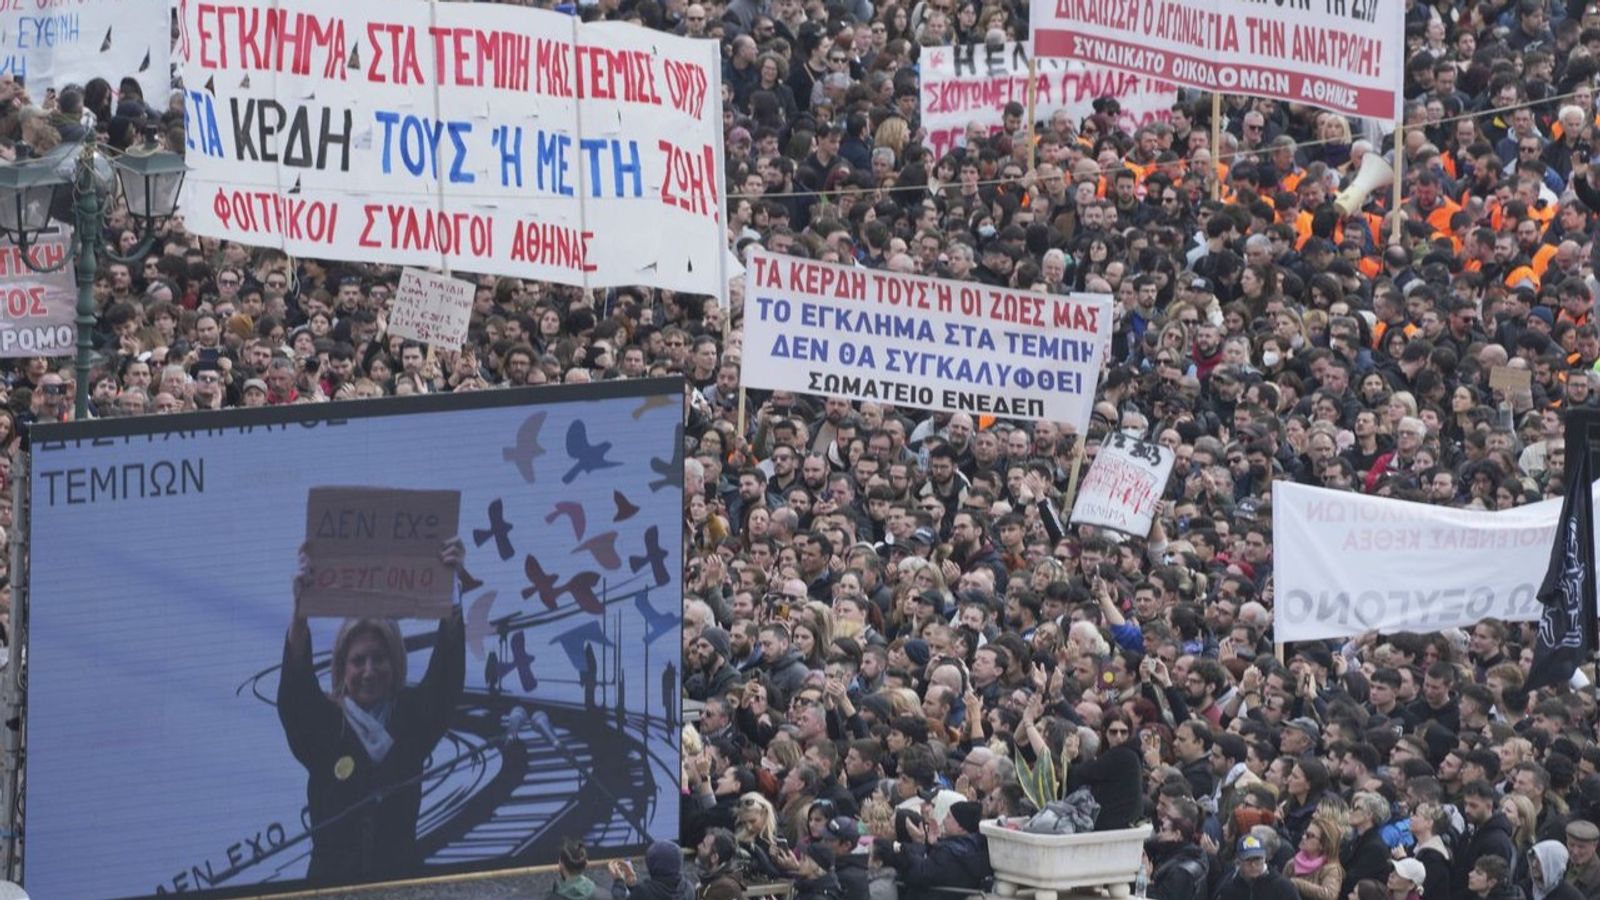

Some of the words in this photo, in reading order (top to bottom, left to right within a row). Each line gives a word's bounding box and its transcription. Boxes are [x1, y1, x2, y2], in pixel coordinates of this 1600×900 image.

[198, 4, 346, 80] ΕΓΚΛΗΜΑ
[367, 22, 424, 85] ΣΤΑ
[429, 27, 530, 92] ΤΕΜΠΗ
[536, 38, 573, 97] ΜΑΣ
[575, 45, 662, 105] ΓΕΜΙΣΕ
[1156, 2, 1204, 48] ΑΓΩΝΑΣ
[1208, 13, 1240, 53] ΓΙΑ
[1246, 17, 1286, 60] ΤΗΝ
[1061, 70, 1141, 106] ΠΑΙΔΙΑ
[1073, 36, 1165, 74] ΣΥΝΔΙΚΑΤΟ
[1172, 57, 1290, 94] ΟΙΚΟΔΟΜΩΝ
[1301, 77, 1358, 110] ΑΘΗΝΑΣ
[230, 97, 352, 171] ΚΕΡΔΗ
[375, 111, 475, 183] ΤΟΥΣ
[537, 131, 574, 196] ΜΕ
[580, 140, 643, 197] ΤΗ
[358, 205, 493, 258] ΣΥΛΛΟΓΟΙ
[510, 220, 598, 271] ΑΘΗΝΑΣ
[753, 257, 783, 290] ΤΑ
[790, 264, 867, 301] ΚΕΡΔΗ
[873, 276, 930, 310] ΤΟΥΣ
[960, 291, 982, 318] ΟΙ
[989, 292, 1046, 328] ΖΩΕΣ
[1053, 302, 1100, 334] ΜΑΣ
[757, 297, 791, 324] ΤΟ
[800, 304, 935, 344] ΕΓΚΛΗΜΑ
[944, 322, 996, 352] ΣΤΑ
[1004, 332, 1095, 364] ΤΕΜΠΗ
[770, 334, 829, 363] ΔΕΝ
[838, 345, 876, 370] ΘΑ
[885, 348, 1083, 395] ΣΥΓΚΑΛΥΦΘΕΙ
[808, 371, 934, 406] ΣΩΜΑΤΕΙΟ
[942, 391, 1045, 418] ΕΝΕΔΕΠ
[40, 457, 205, 507] ΤΕΜΠΩΝ
[317, 508, 376, 539] ΔΕΝ
